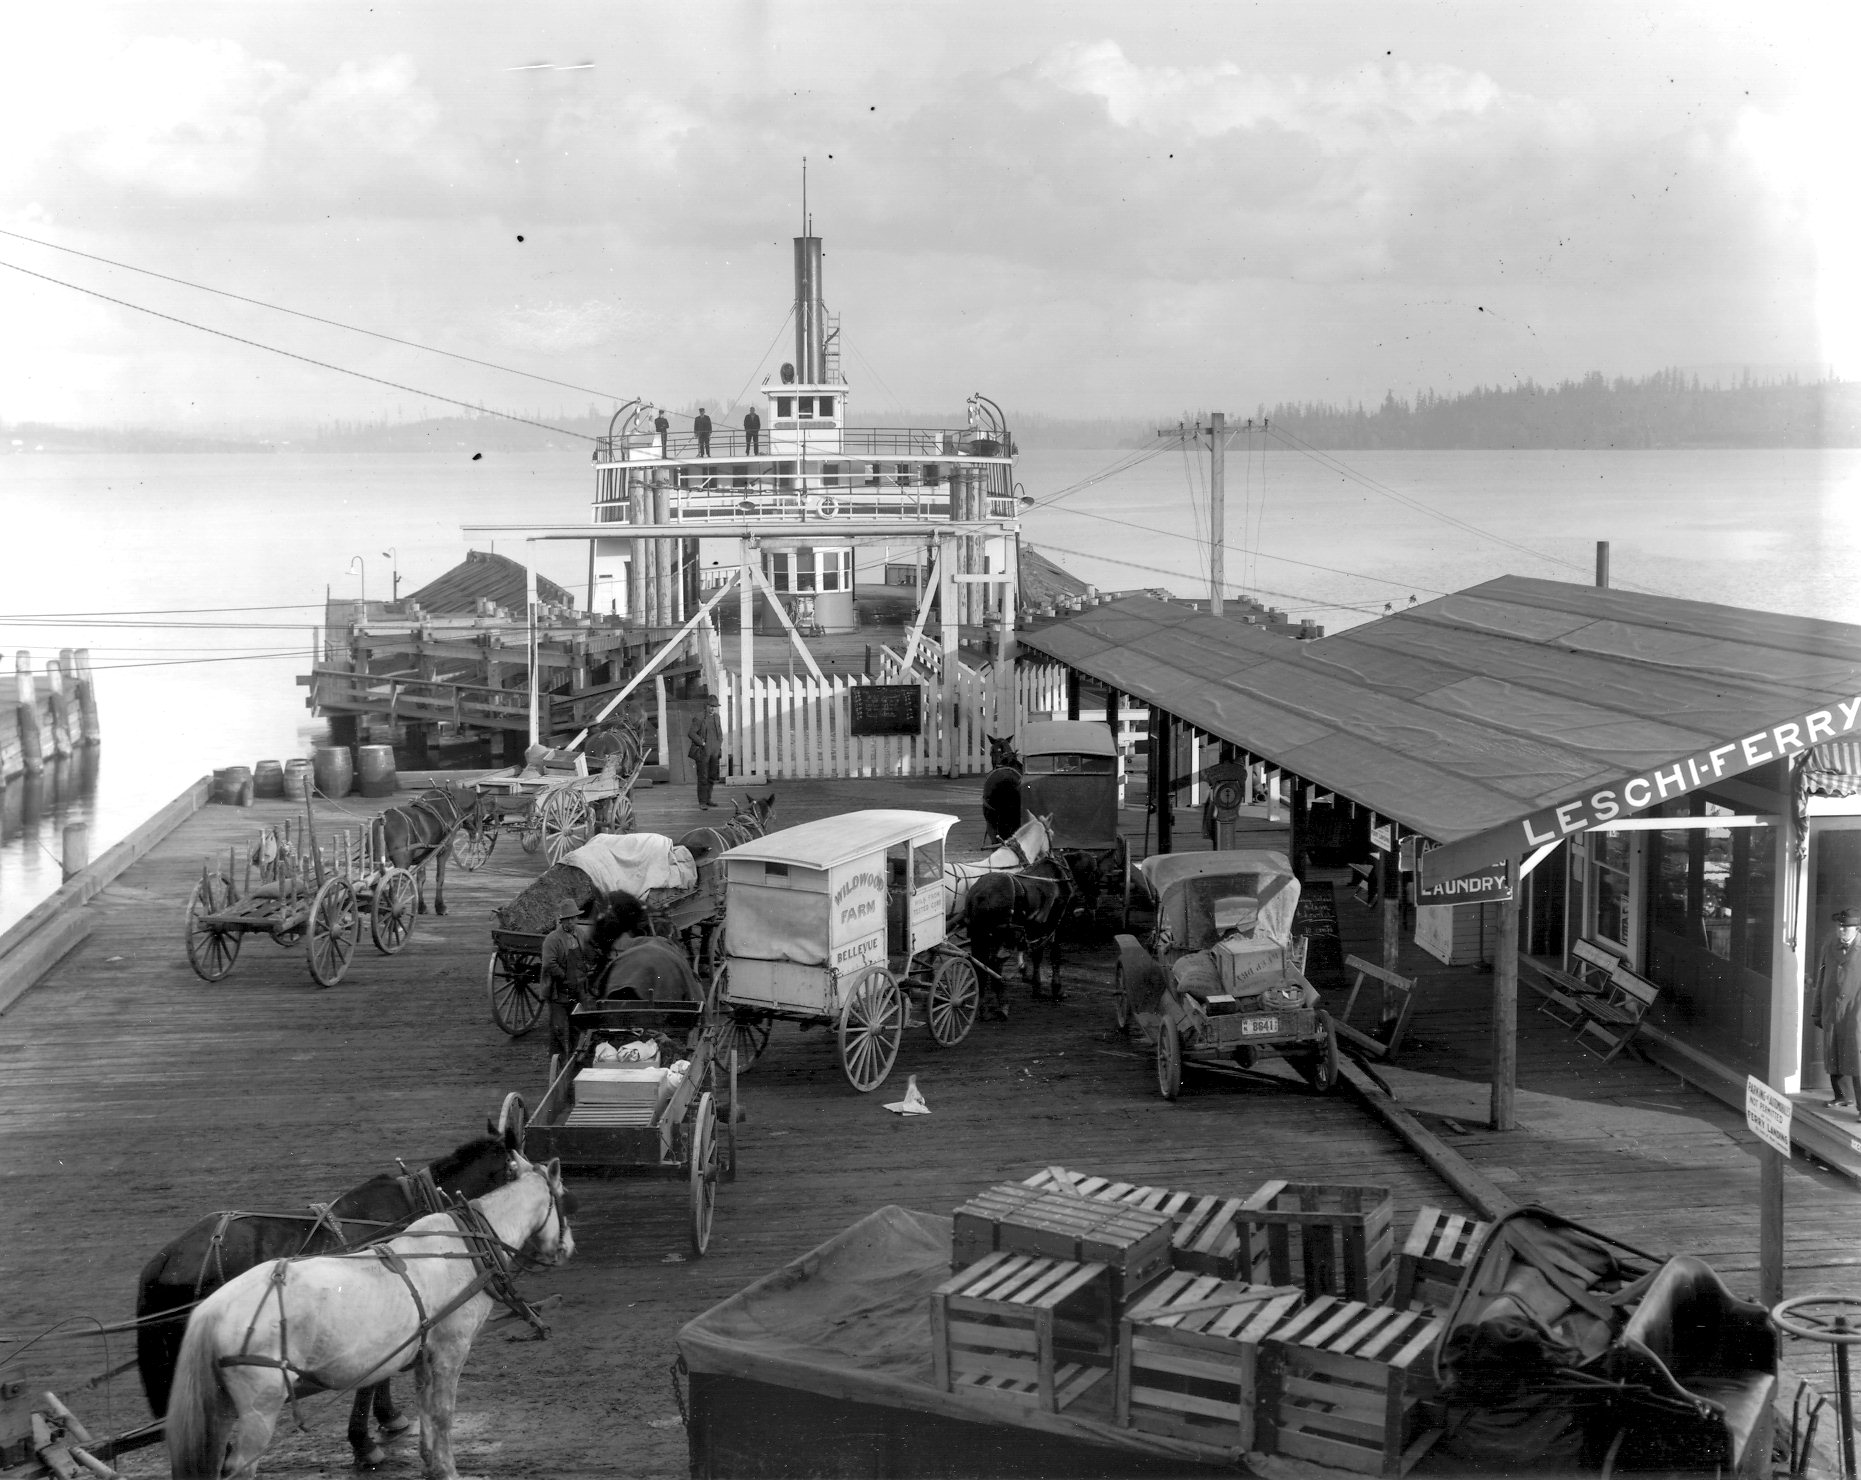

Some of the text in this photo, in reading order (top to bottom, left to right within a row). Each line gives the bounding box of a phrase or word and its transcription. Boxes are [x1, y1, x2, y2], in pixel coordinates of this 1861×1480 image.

[1522, 697, 1861, 846] LESCHI-FERRY
[834, 872, 885, 906] WILDWOOD
[841, 900, 876, 924] FARM
[837, 938, 878, 963] BELLEVUE
[1747, 1110, 1765, 1129] FERRY
[1767, 1123, 1788, 1145] LANDING
